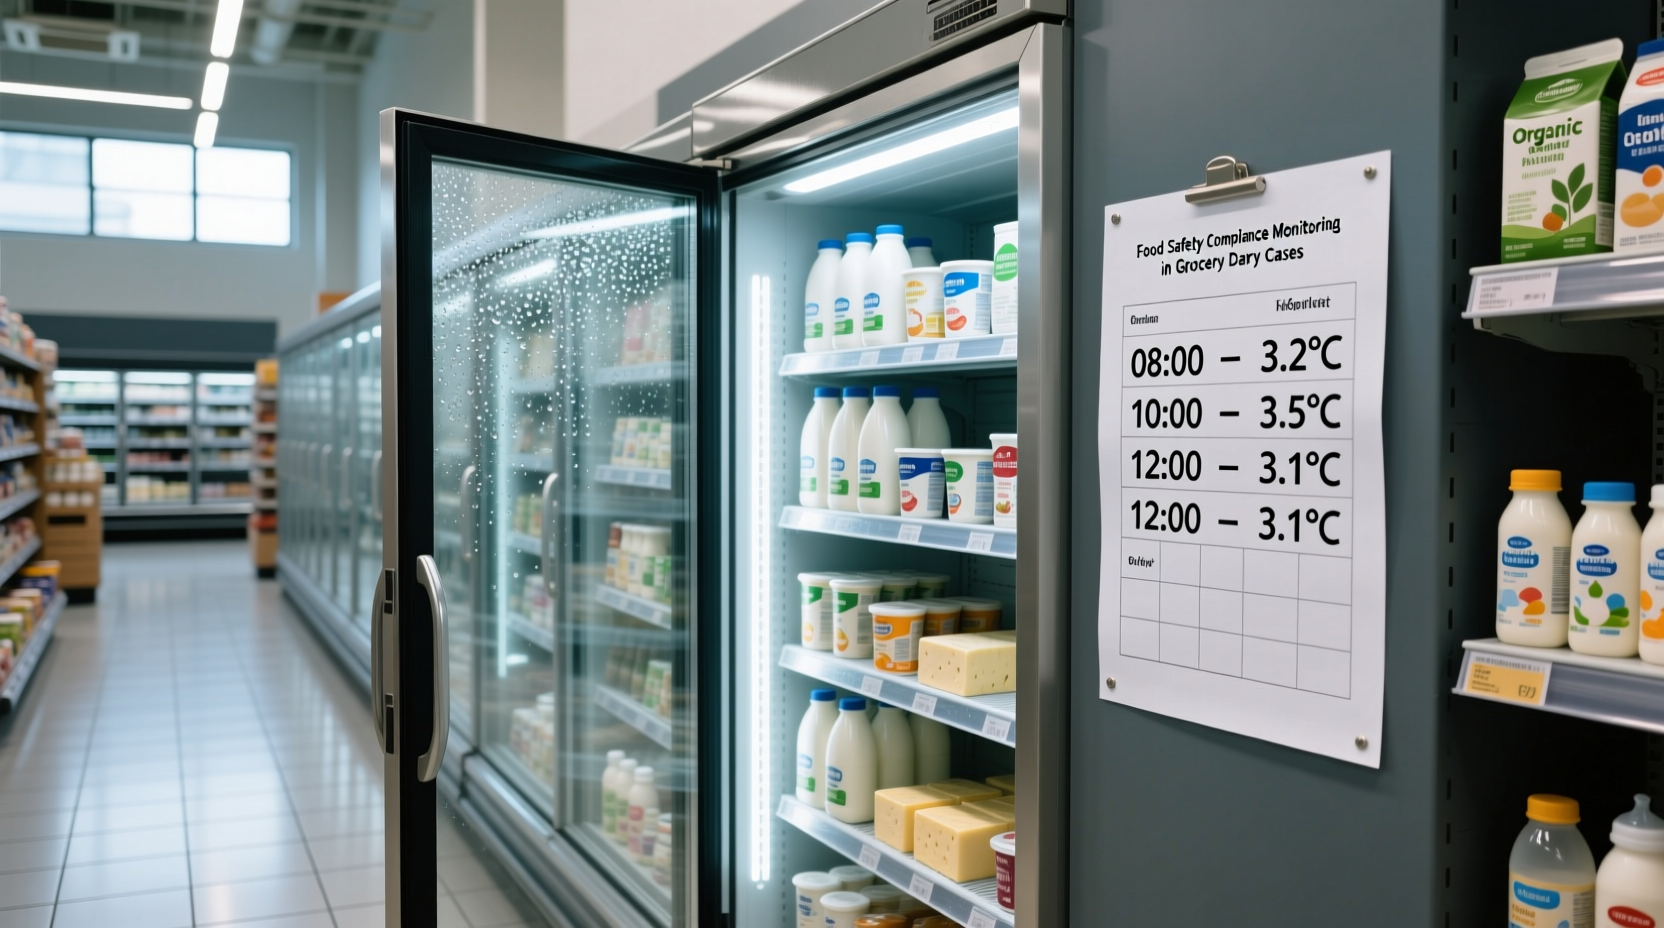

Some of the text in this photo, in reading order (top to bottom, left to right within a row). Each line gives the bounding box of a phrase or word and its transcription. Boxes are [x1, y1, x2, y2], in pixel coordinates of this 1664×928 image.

[1513, 117, 1583, 146] Organic
[1136, 240, 1164, 258] Food
[1272, 215, 1341, 239] Monitoring
[1161, 246, 1304, 276] in Grocery Dary Cases
[1130, 344, 1204, 378] 08:00
[1260, 334, 1343, 373] 3.2°C
[1131, 397, 1203, 429] 10:00
[1259, 393, 1342, 430] 3.5°C
[1131, 449, 1202, 482] 12:00
[1259, 450, 1341, 487] 3.1°C
[1131, 499, 1201, 535] 12:00
[1258, 506, 1341, 546] 3.1°C
